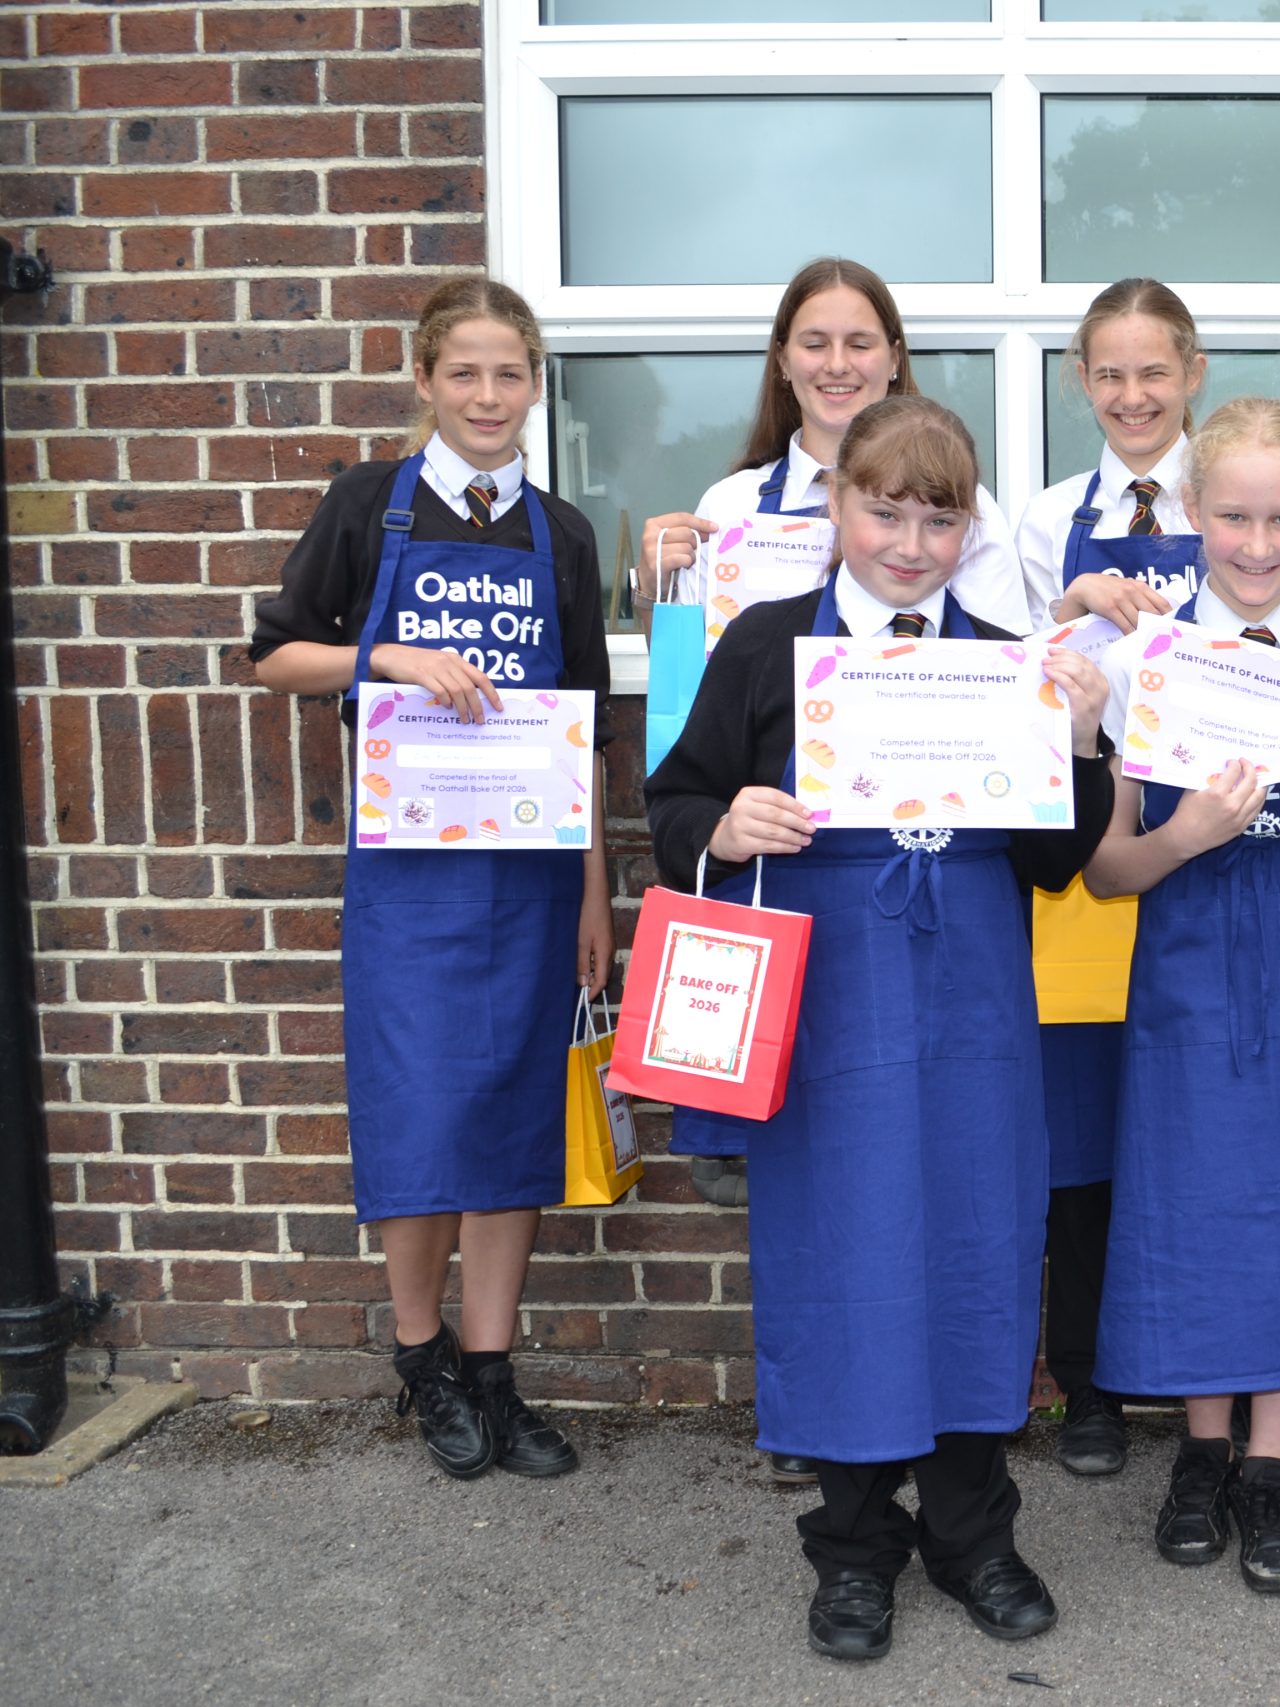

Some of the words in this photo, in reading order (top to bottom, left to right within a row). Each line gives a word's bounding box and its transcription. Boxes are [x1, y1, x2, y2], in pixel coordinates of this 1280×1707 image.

[747, 540, 808, 550] CERTIFICATE
[415, 571, 533, 607] Oathall
[398, 610, 483, 641] Bake
[491, 612, 544, 646] Off
[440, 646, 526, 682] 026
[1174, 652, 1236, 674] CERTIFICATE
[1239, 668, 1252, 678] OF
[842, 672, 915, 680] CERTIFICATE
[918, 673, 934, 681] OF
[938, 674, 1017, 683] ACHIEVEMENT
[1202, 675, 1216, 684] This
[1217, 680, 1251, 694] certificate
[876, 690, 892, 698] This
[894, 691, 936, 699] certificate
[398, 714, 460, 724] CERTIFICATE
[1199, 718, 1236, 733] Competed
[880, 738, 924, 748] Competed
[1190, 726, 1204, 736] The
[1207, 731, 1237, 744] Oathall
[1240, 739, 1260, 748] Bake
[870, 752, 888, 760] The
[890, 752, 926, 760] Oathall
[929, 752, 952, 760] Bake
[972, 753, 996, 761] 2026
[429, 773, 468, 781] Competed
[438, 784, 468, 792] Oathall
[716, 982, 740, 995] OFF
[689, 998, 720, 1013] 2026
